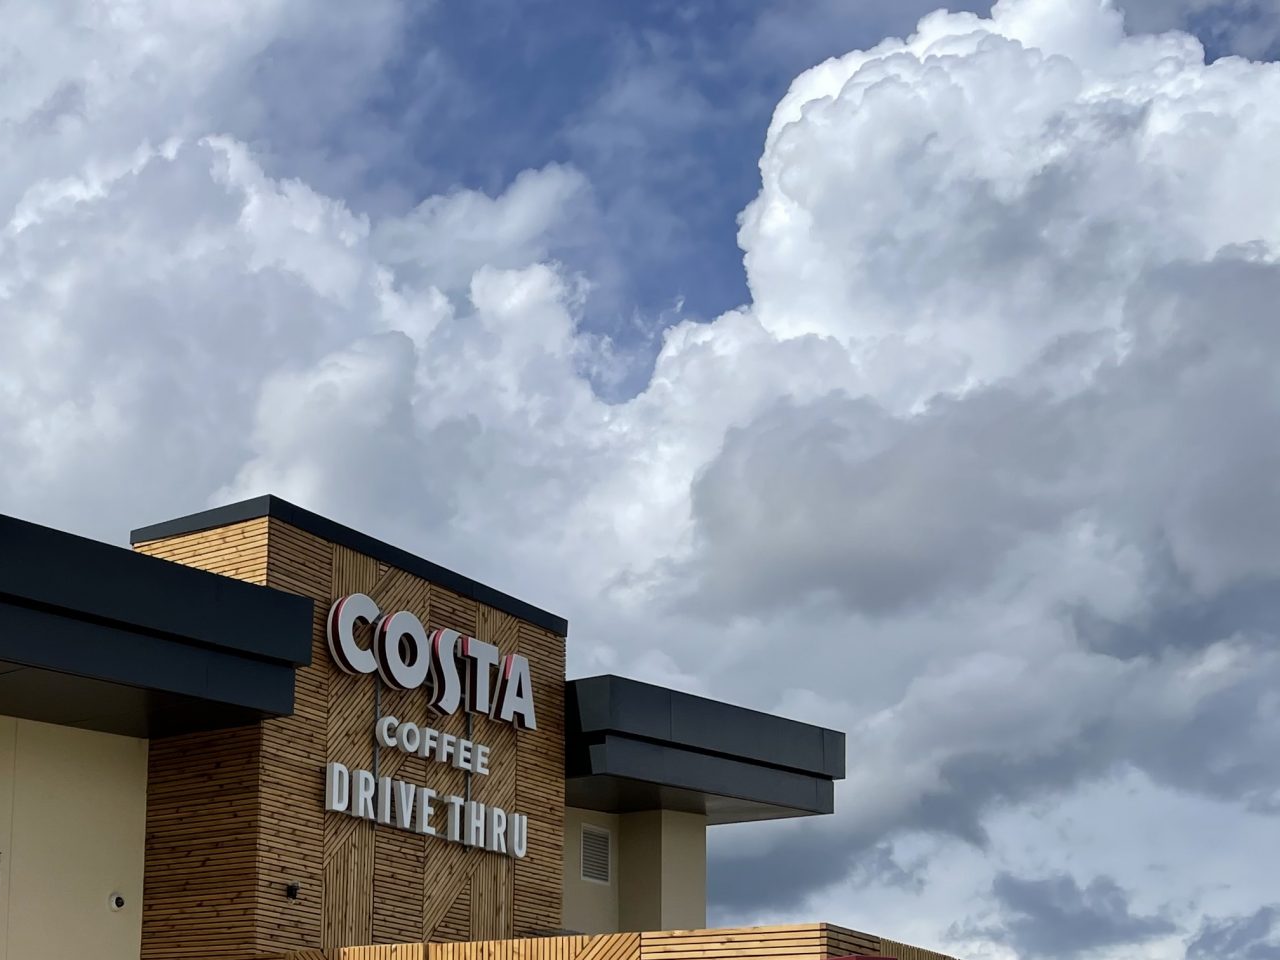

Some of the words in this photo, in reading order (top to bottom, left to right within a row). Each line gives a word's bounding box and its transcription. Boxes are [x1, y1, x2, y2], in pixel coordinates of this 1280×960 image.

[327, 593, 537, 730] COSTA
[376, 716, 490, 775] COFFEE
[326, 762, 436, 835] DRIVE
[444, 795, 528, 858] THRU
